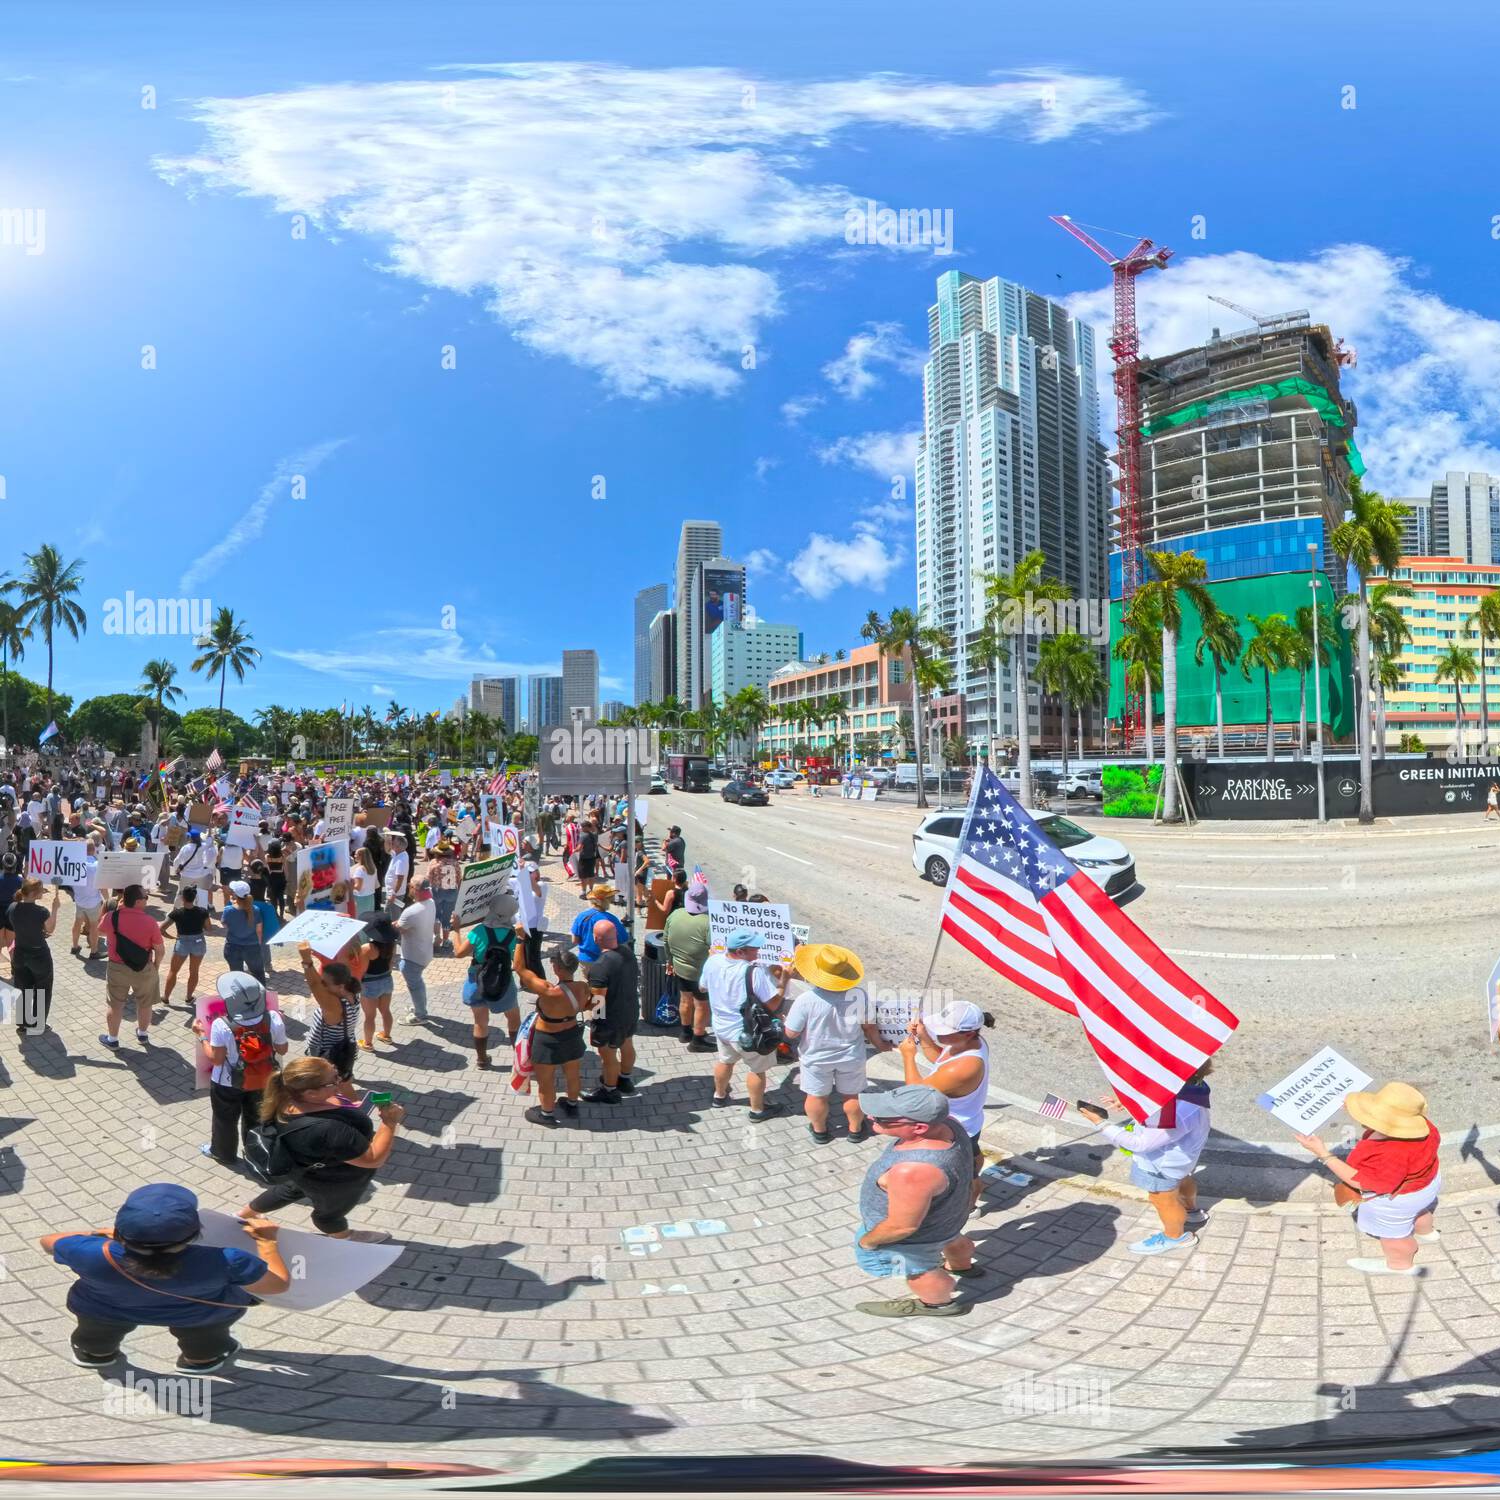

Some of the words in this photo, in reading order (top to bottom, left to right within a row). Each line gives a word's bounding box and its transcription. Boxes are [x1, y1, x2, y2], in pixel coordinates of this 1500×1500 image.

[1400, 769, 1443, 780] GREEN
[1227, 779, 1286, 790] PARKING
[1222, 789, 1292, 800] AVAILABLE
[31, 848, 52, 875] No
[54, 846, 87, 882] Kings
[723, 903, 737, 913] No
[742, 905, 780, 919] Reyes,
[711, 913, 725, 923] No
[727, 915, 790, 930] Dictadores
[764, 931, 785, 941] dice
[761, 943, 782, 952] ump
[1271, 1057, 1336, 1108] IMMIGRANTS
[1293, 1091, 1316, 1110] ARE
[1314, 1072, 1337, 1094] NOT
[1300, 1077, 1354, 1121] CRIMINALS
